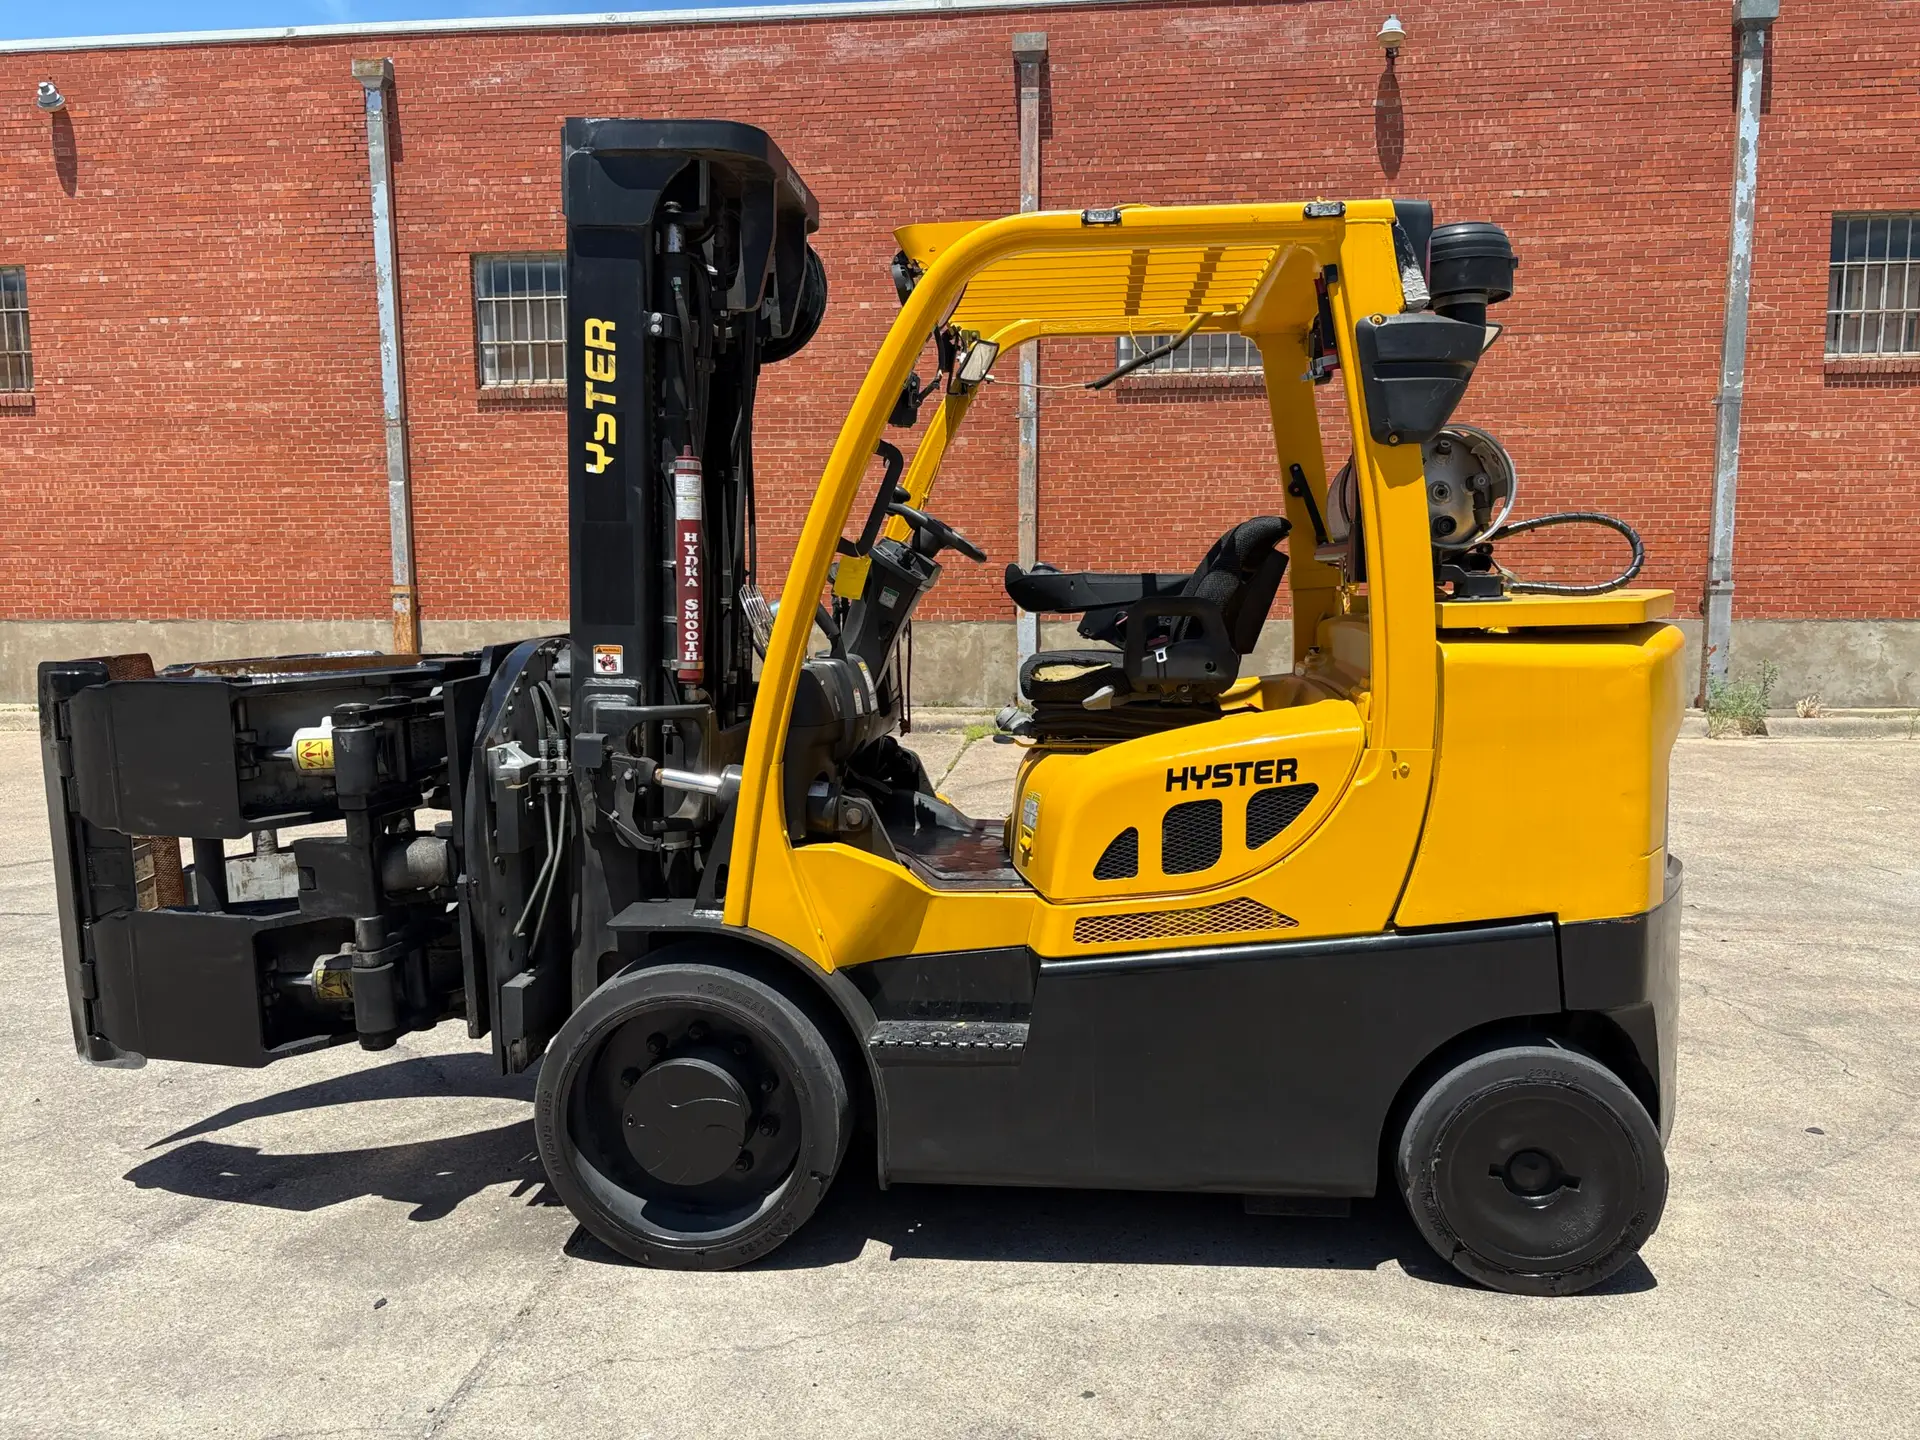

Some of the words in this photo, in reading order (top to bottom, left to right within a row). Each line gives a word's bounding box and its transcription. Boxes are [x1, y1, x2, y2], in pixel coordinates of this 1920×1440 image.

[585, 318, 616, 474] YSTER
[684, 532, 699, 587] HYDRA
[684, 599, 699, 661] SMOOTH
[1165, 757, 1298, 792] HYSTER
